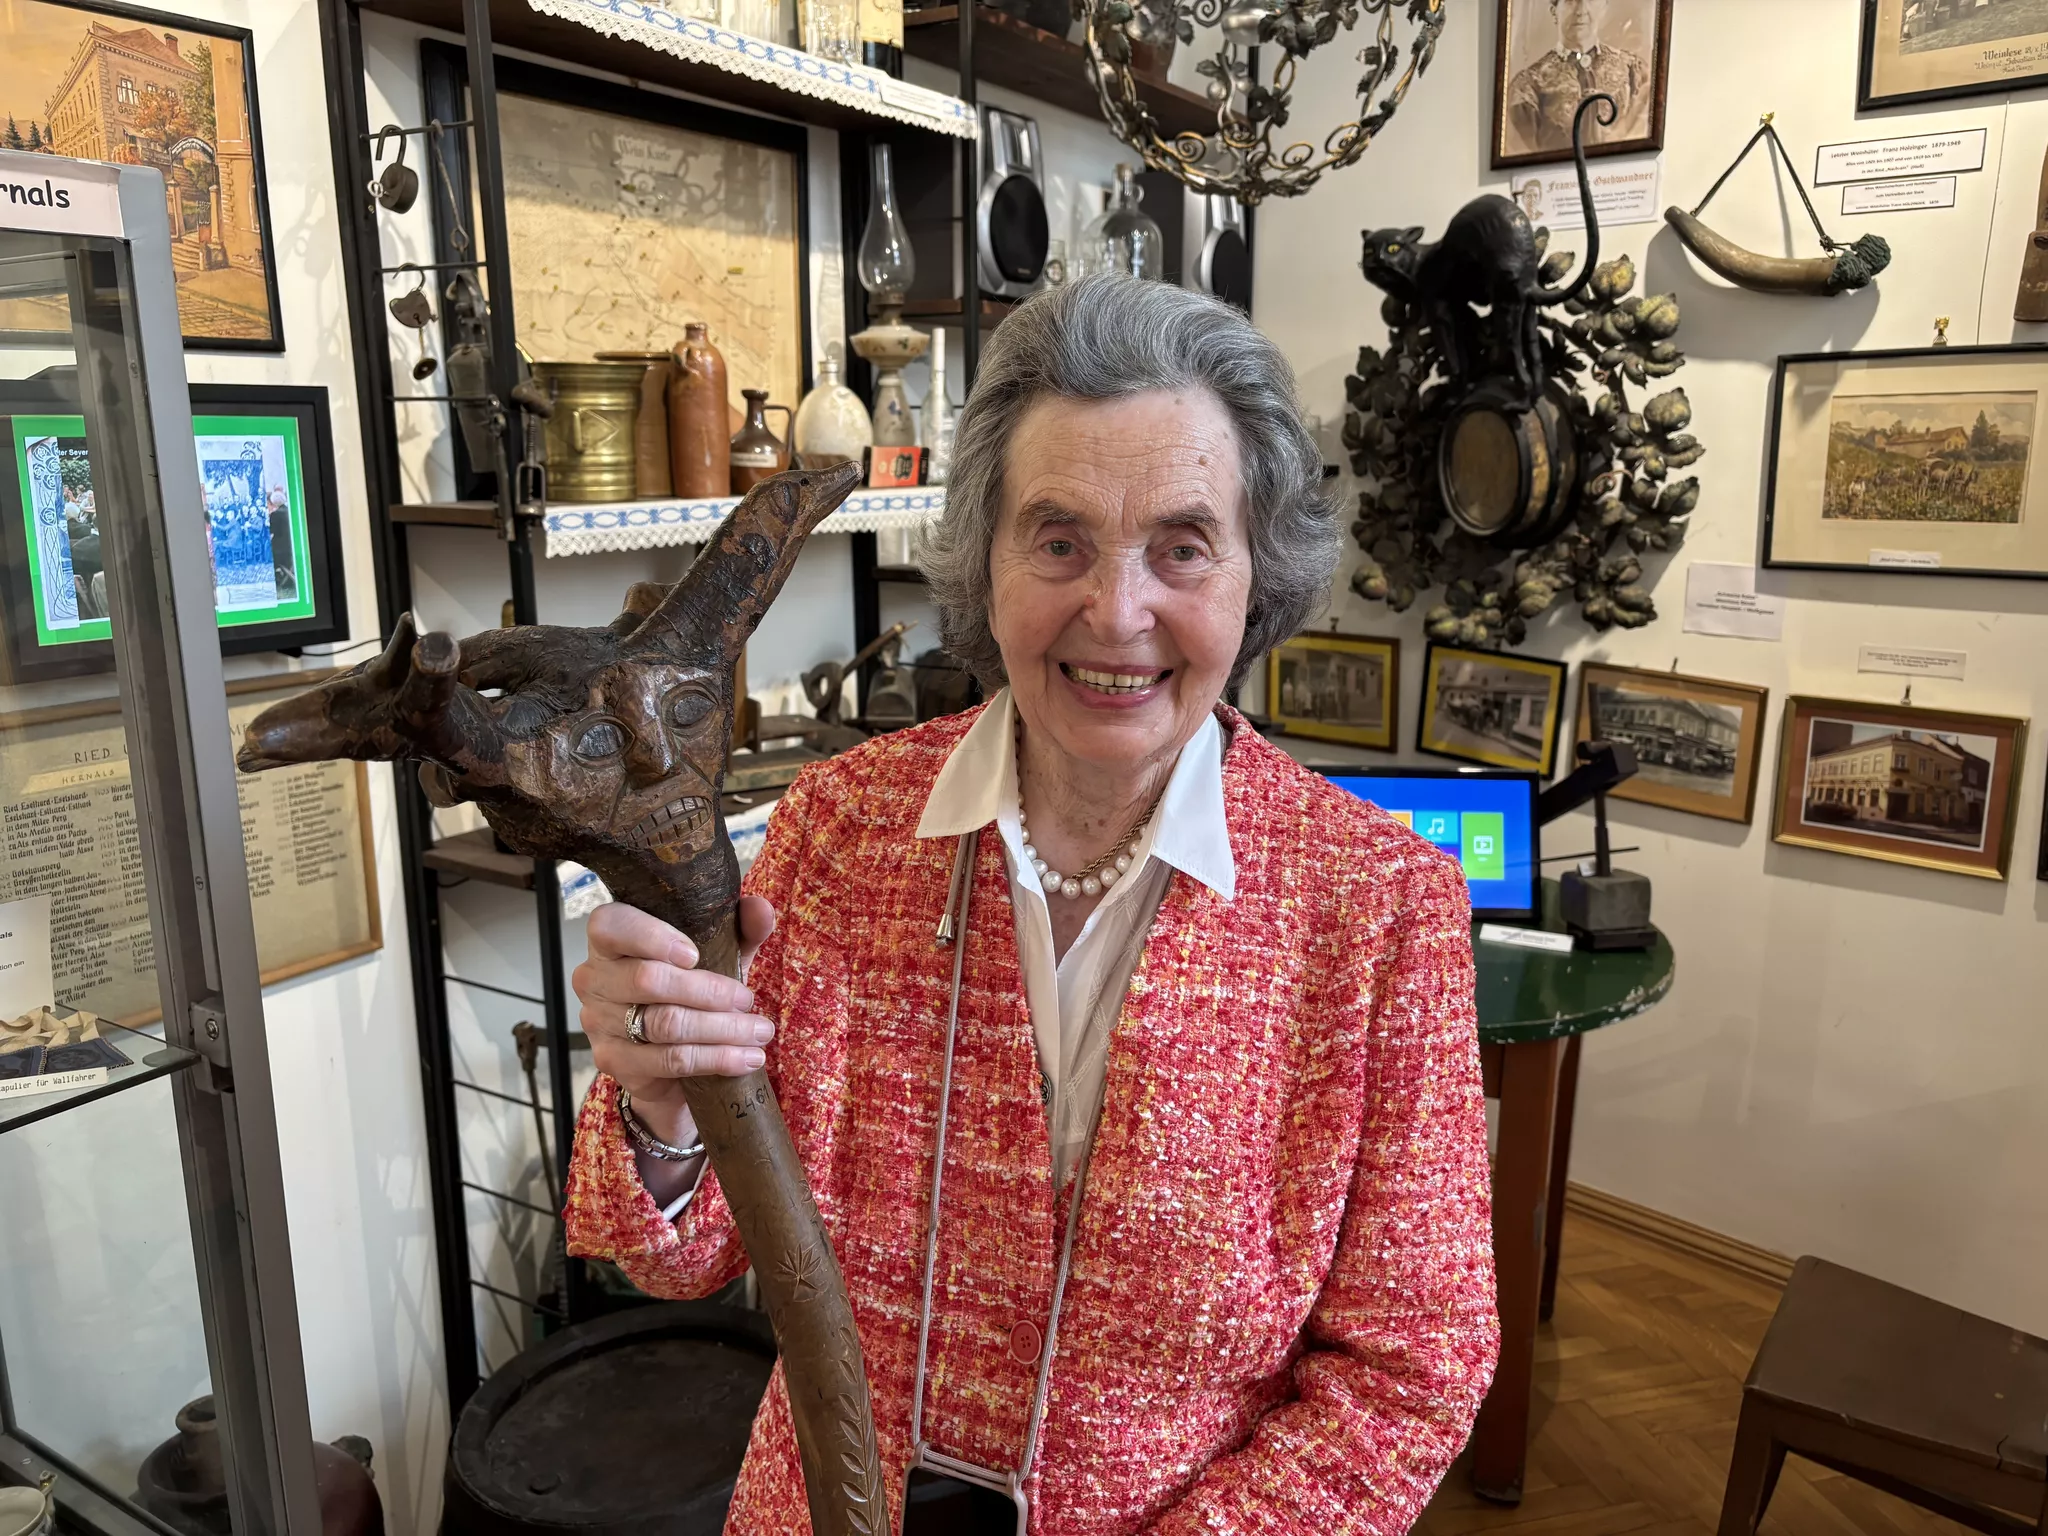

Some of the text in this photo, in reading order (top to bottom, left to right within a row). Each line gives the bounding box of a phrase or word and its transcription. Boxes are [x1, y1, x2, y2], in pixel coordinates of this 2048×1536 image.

[1983, 48, 2022, 60] Weinlese
[74, 747, 111, 764] RIED
[62, 769, 115, 785] HERNALS
[36, 1079, 49, 1087] für
[53, 1073, 96, 1085] Wallfahrer
